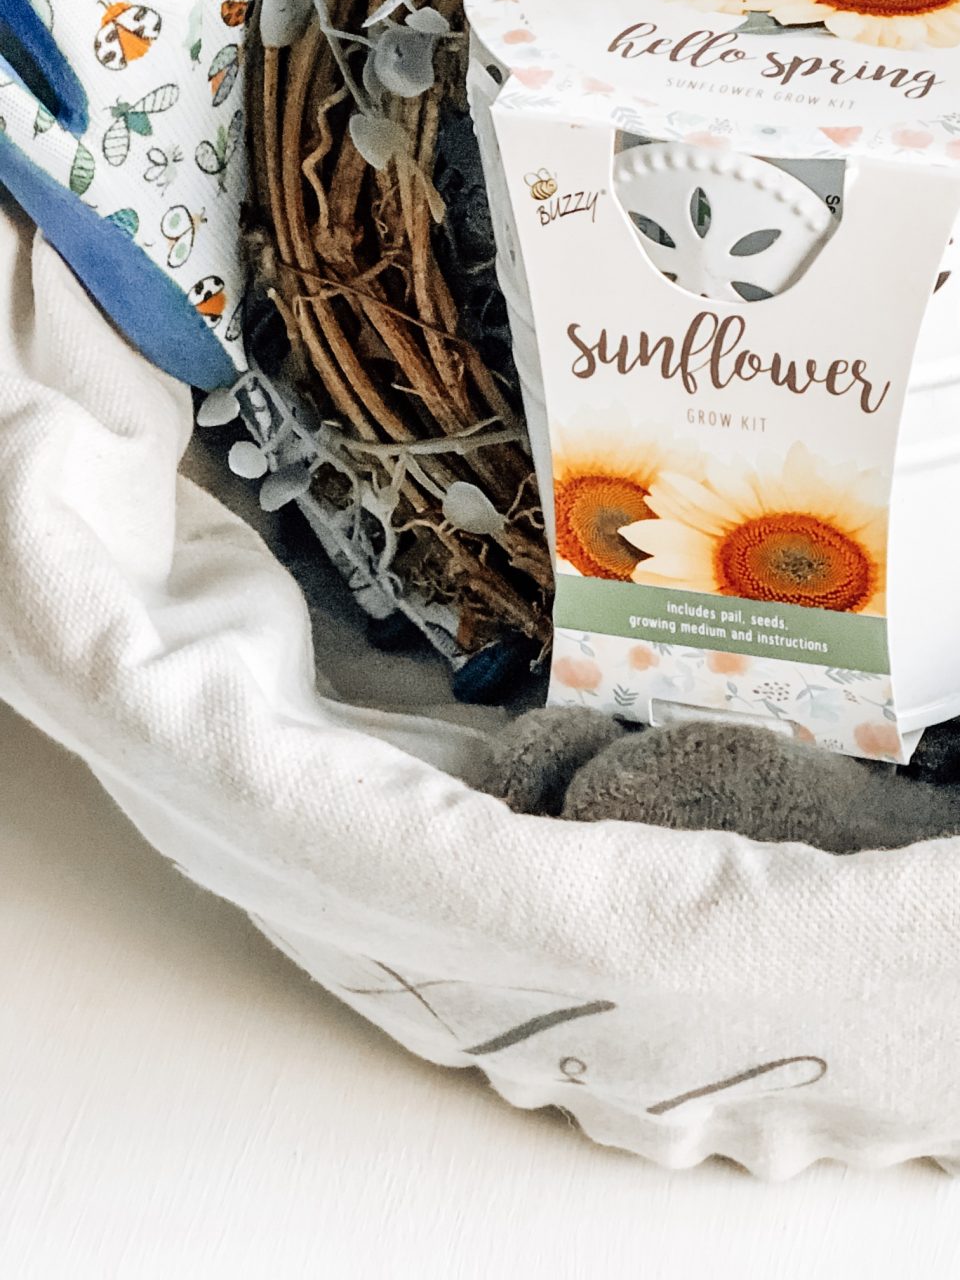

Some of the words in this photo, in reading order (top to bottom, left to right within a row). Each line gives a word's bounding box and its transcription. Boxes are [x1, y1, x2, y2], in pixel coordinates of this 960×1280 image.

[607, 22, 757, 68] hello
[760, 50, 946, 100] spring
[665, 76, 765, 100] SUNFLOWER
[773, 91, 822, 106] GROW
[829, 98, 857, 111] KIT
[566, 310, 892, 414] sunflower
[686, 408, 733, 429] GROW
[740, 416, 769, 432] KIT
[666, 600, 716, 620] includes
[628, 615, 677, 634] growing
[680, 621, 727, 639] medium
[731, 628, 753, 643] and
[756, 631, 829, 654] instructions
